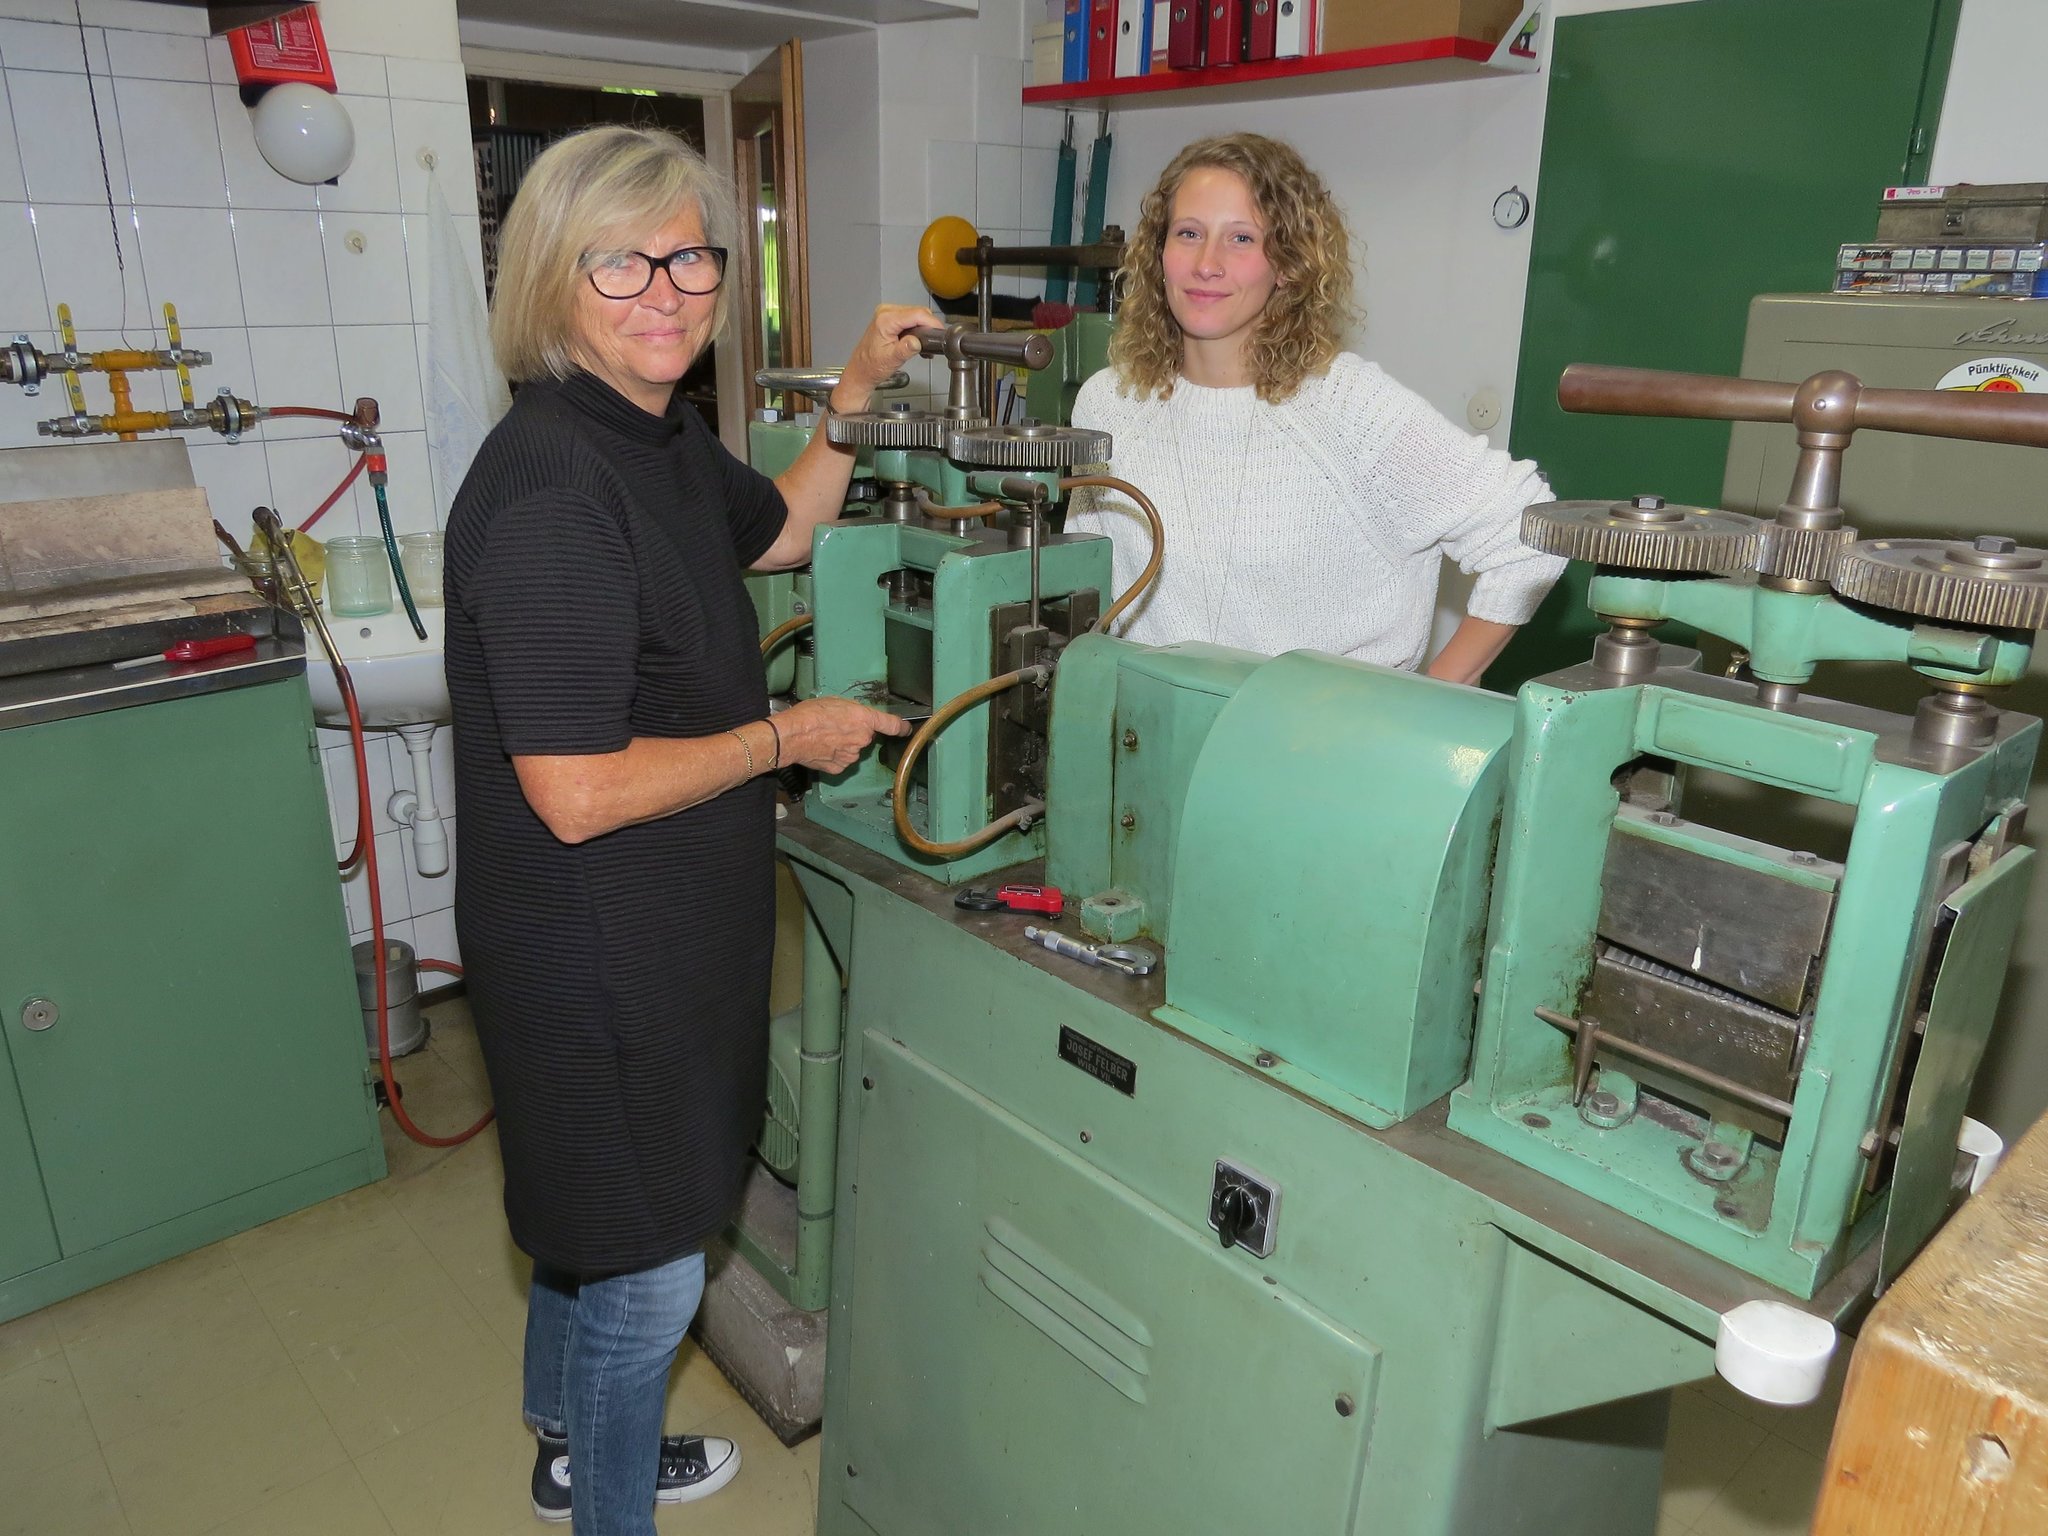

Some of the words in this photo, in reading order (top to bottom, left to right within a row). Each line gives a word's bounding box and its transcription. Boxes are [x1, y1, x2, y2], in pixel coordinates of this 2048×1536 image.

[1855, 248, 1894, 261] Energizer
[1854, 274, 1893, 284] Energizer
[1967, 362, 2040, 382] Pünktlichkeit
[1066, 1039, 1094, 1061] JOSEF
[1095, 1055, 1129, 1082] FELBER
[1077, 1057, 1098, 1076] WIEN
